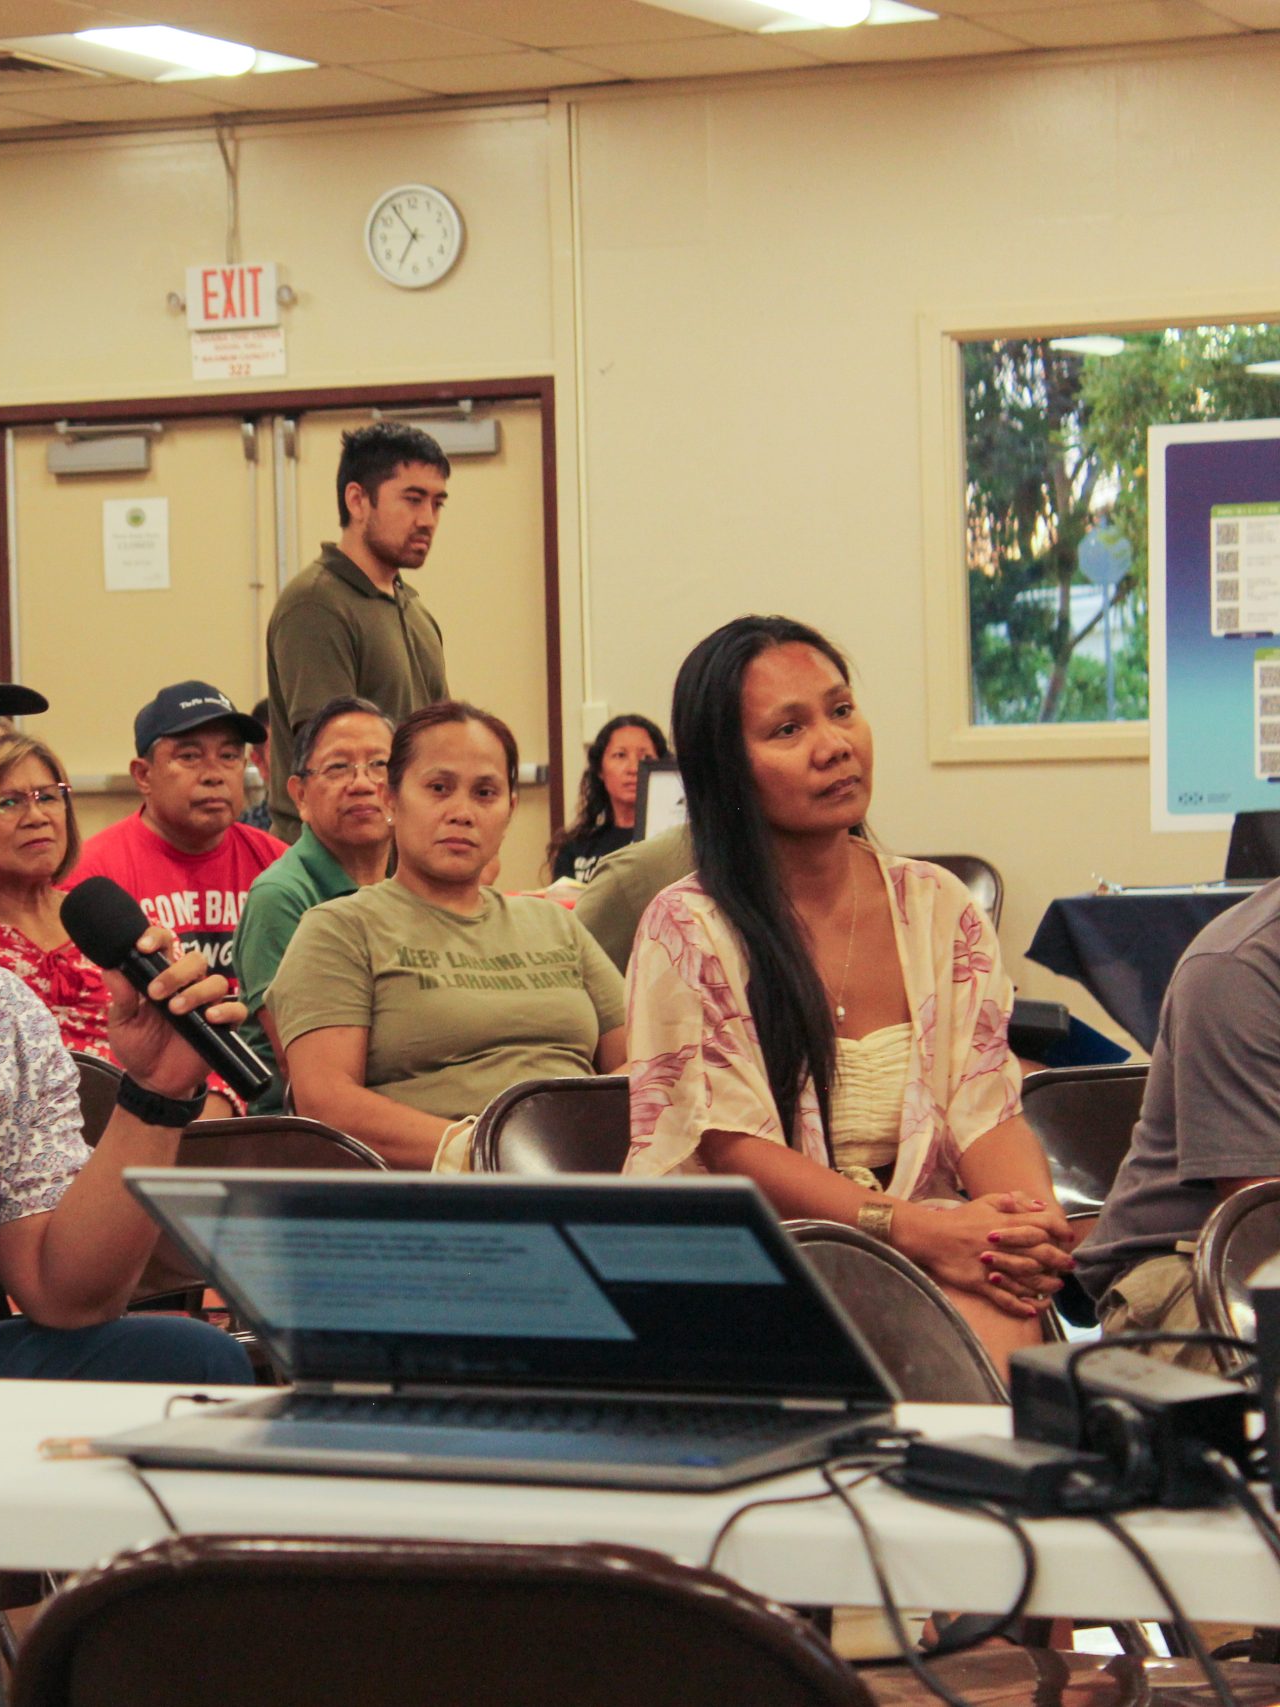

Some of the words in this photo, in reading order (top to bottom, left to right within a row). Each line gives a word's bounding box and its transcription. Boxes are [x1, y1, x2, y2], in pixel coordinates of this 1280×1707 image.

[202, 267, 262, 320] EXIT
[397, 946, 439, 968] KEEP
[446, 952, 527, 971] LAHAINA
[441, 974, 528, 990] LAHAINA
